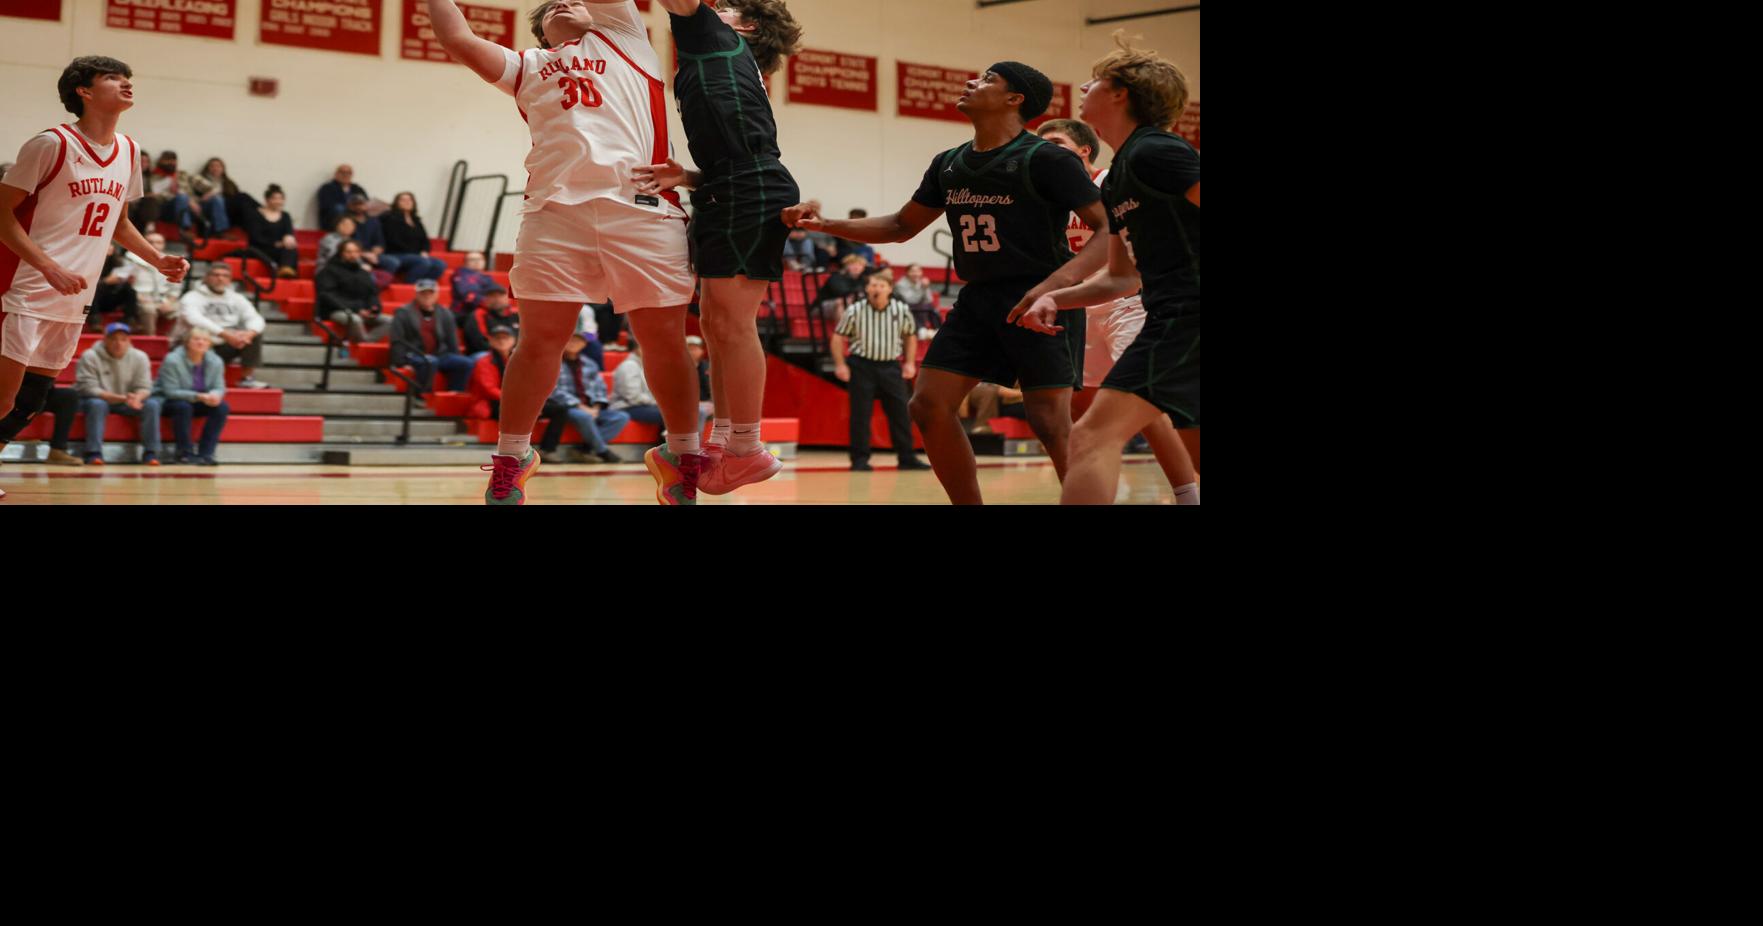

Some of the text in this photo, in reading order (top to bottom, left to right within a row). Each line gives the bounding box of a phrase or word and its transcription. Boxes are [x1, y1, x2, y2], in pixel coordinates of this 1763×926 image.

[538, 56, 607, 80] RULAND
[794, 62, 870, 81] CHAMPIONS
[558, 77, 603, 110] 30
[945, 188, 1015, 208] Hilltoppers
[79, 202, 110, 237] 12
[960, 214, 1001, 252] 23
